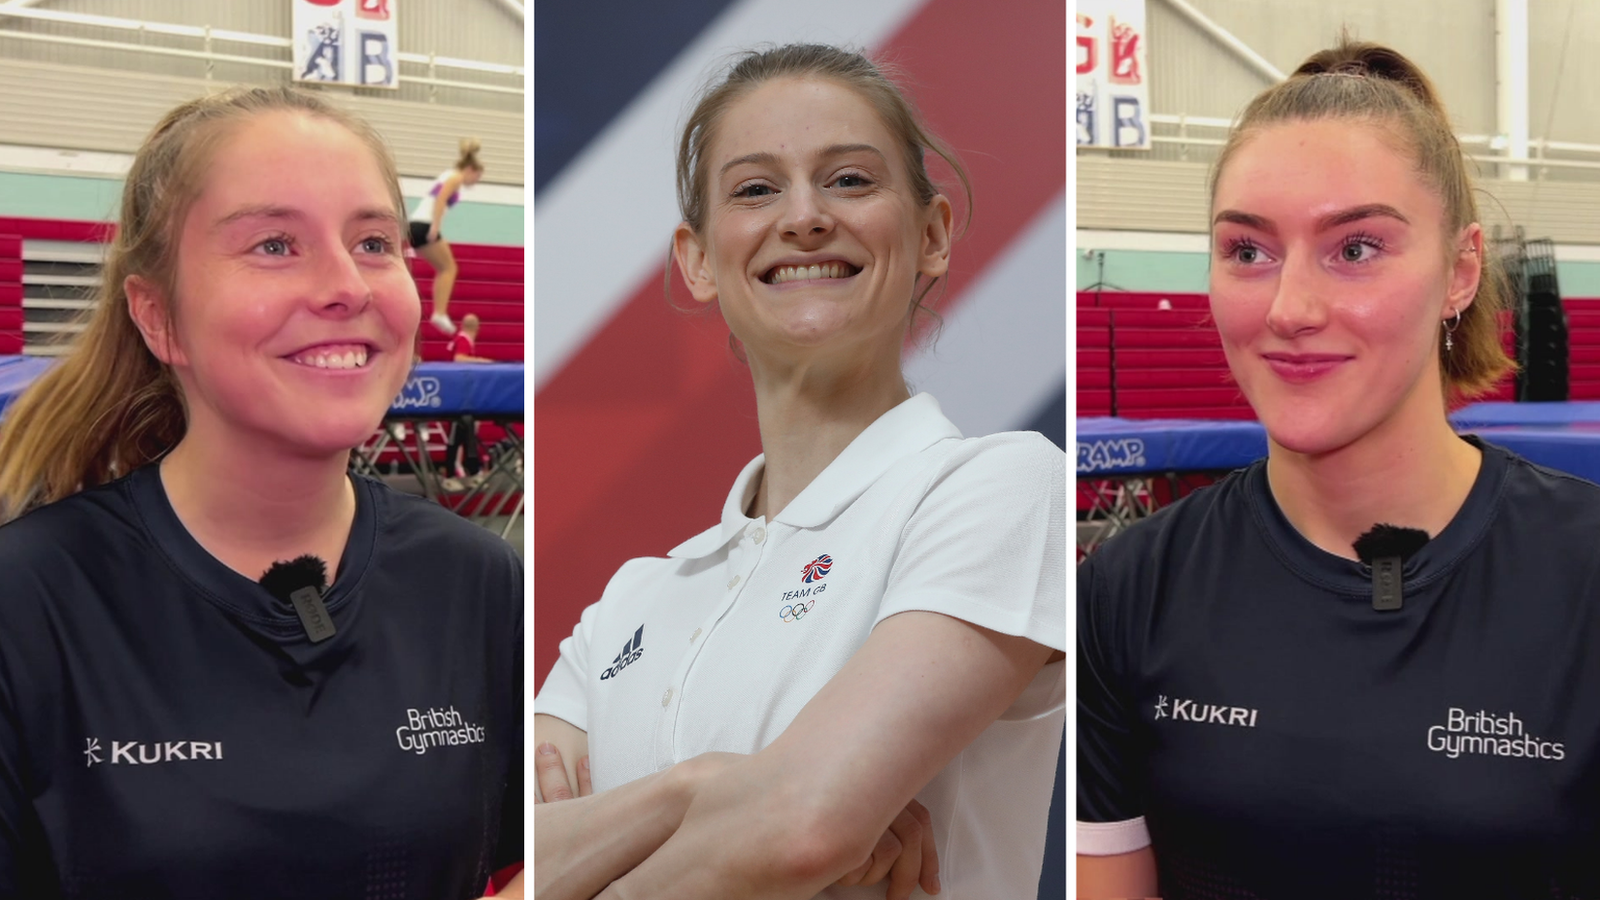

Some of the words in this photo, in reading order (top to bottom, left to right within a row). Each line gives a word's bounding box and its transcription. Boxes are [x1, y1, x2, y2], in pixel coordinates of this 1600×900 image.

[781, 588, 812, 602] TEAM
[813, 583, 827, 596] GB
[600, 647, 645, 681] adidas
[406, 705, 462, 734] British
[1172, 698, 1258, 727] KUKRI
[1447, 707, 1523, 737] British
[395, 720, 486, 755] Gymnastics
[1426, 724, 1566, 761] Gymnastics
[110, 740, 224, 765] KUKRI
